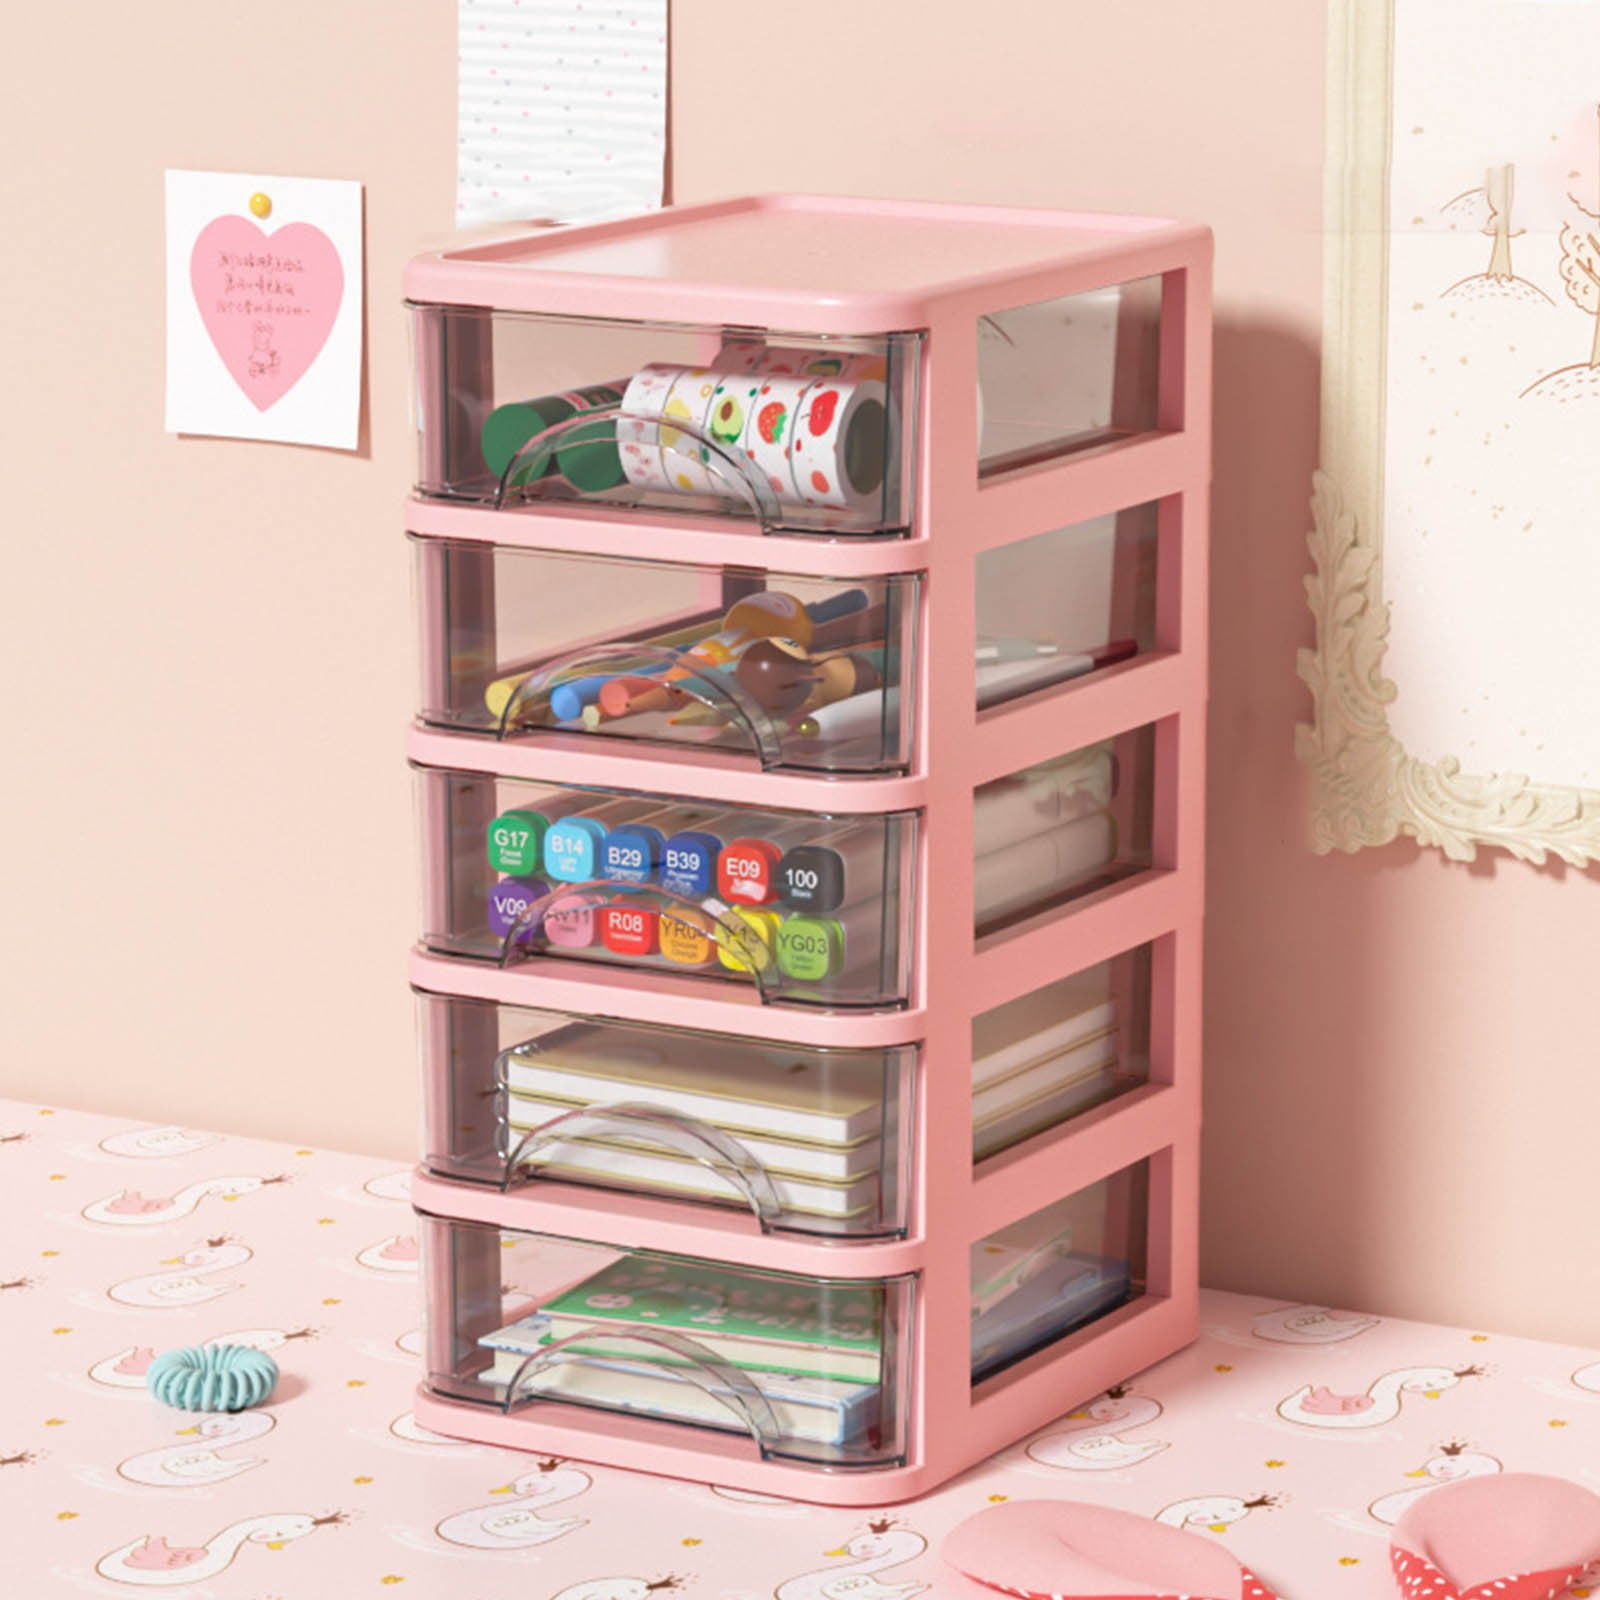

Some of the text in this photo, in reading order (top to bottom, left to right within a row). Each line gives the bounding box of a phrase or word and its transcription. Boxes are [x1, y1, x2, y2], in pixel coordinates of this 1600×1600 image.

[494, 828, 529, 849] G17
[551, 834, 585, 856] B14
[608, 846, 642, 868] B29
[666, 849, 700, 871] B39
[726, 857, 760, 879] E09
[785, 868, 818, 889] 100
[494, 896, 527, 916] V09
[608, 911, 643, 933] R08
[777, 932, 827, 955] YG03
